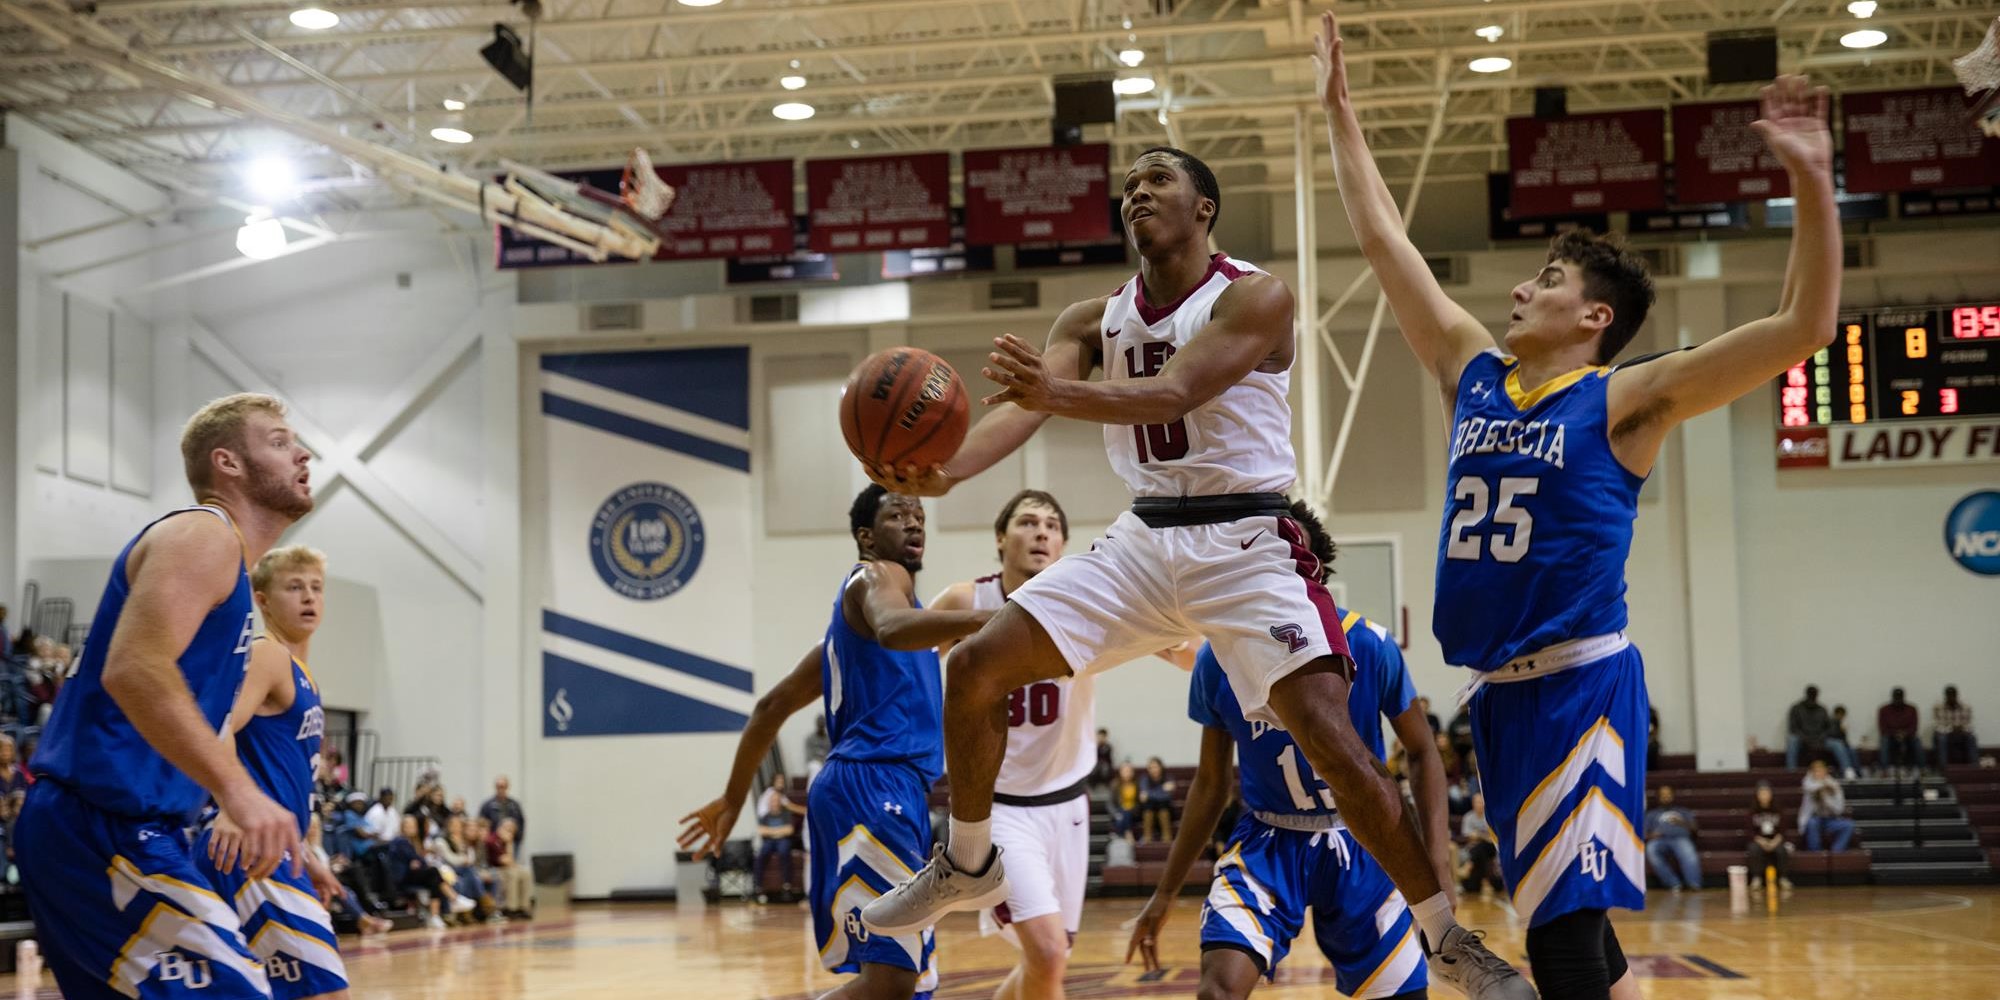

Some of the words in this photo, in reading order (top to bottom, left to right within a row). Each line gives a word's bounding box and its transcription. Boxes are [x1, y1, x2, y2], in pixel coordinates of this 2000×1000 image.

[1450, 416, 1566, 470] BRESCIA
[1841, 426, 1957, 462] LADY
[1447, 475, 1540, 563] 25
[1577, 841, 1609, 883] BU
[156, 950, 214, 990] BU
[265, 955, 303, 983] BU
